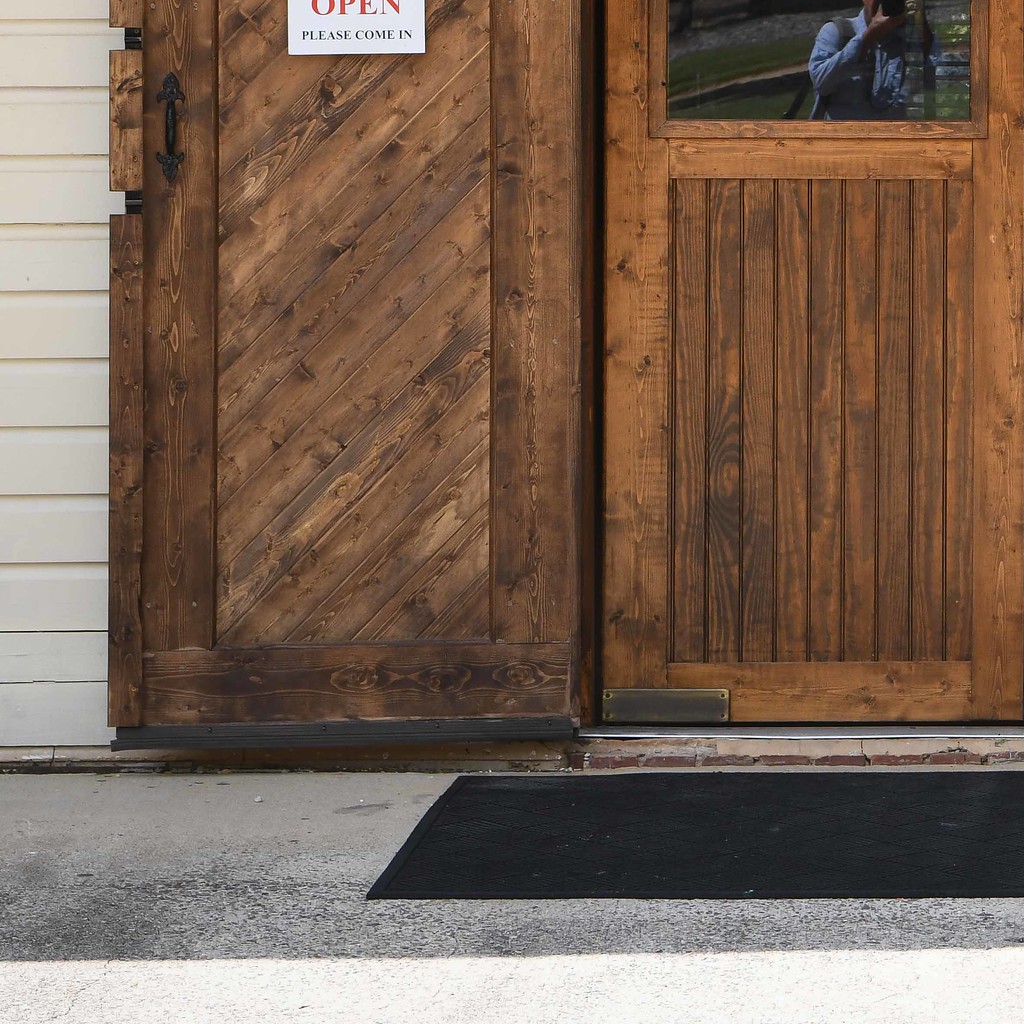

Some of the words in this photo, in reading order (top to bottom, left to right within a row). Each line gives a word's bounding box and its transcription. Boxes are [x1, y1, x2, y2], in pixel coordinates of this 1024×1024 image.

[302, 30, 351, 41] PLEASE
[355, 29, 395, 40] COME
[399, 29, 413, 40] IN
